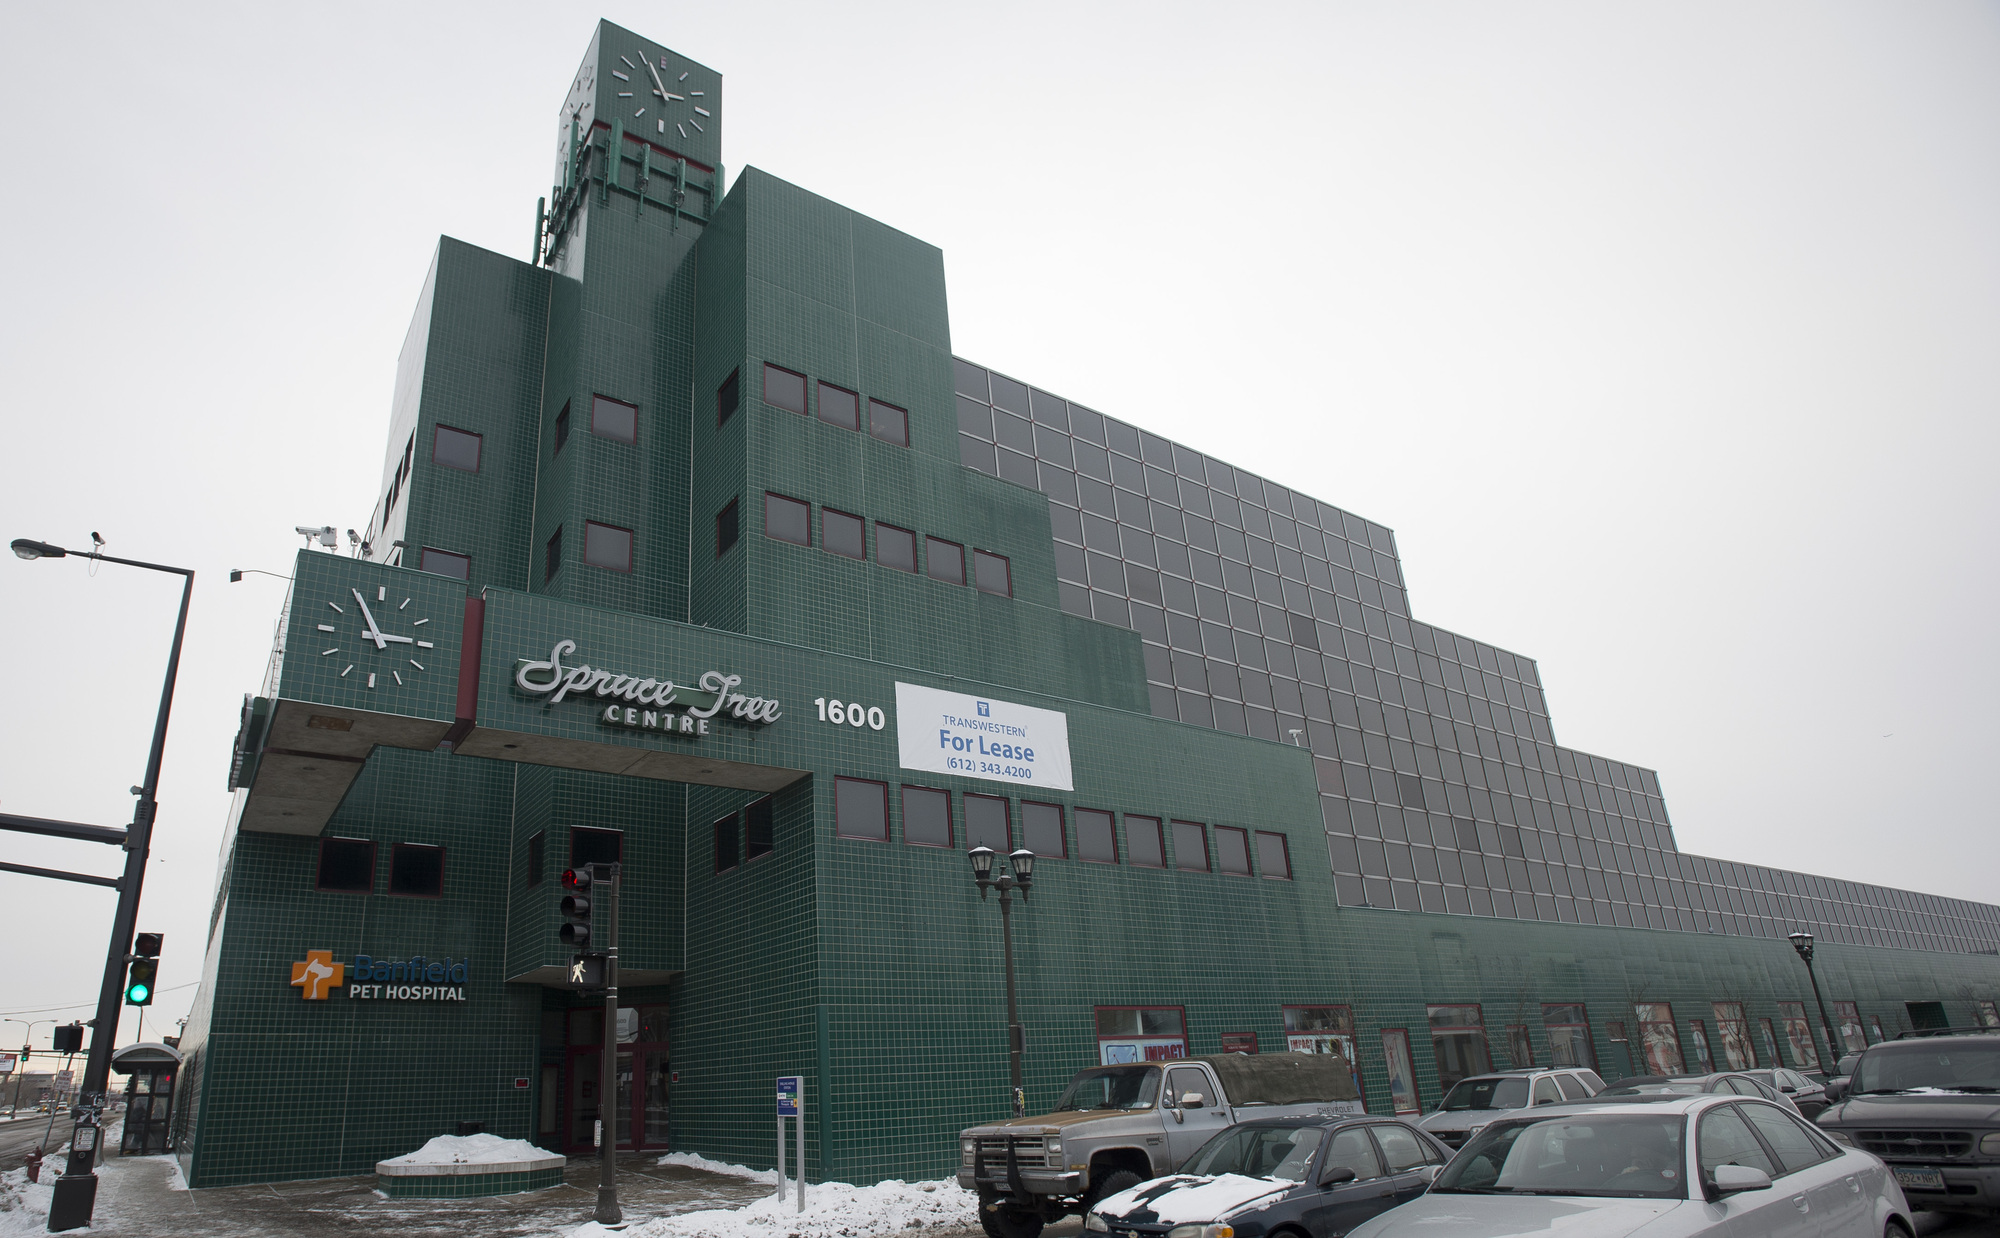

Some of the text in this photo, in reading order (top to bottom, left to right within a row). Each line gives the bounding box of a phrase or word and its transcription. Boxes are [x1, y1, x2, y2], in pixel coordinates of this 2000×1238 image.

[516, 639, 783, 725] Spruce Tree
[604, 704, 710, 736] CENTRE
[814, 697, 886, 732] 1600
[943, 715, 1026, 738] TRANSWESTERN
[939, 729, 1035, 762] For Lease
[946, 756, 1032, 779] (612) 343.4200
[352, 954, 468, 984] Banfield
[349, 983, 467, 1001] PET HOSPITAL
[1144, 1044, 1184, 1062] IMPACT
[1290, 1039, 1314, 1051] IMPACT
[1317, 1105, 1355, 1115] CHEVROLET
[1897, 1172, 1940, 1184] 352 NRY
